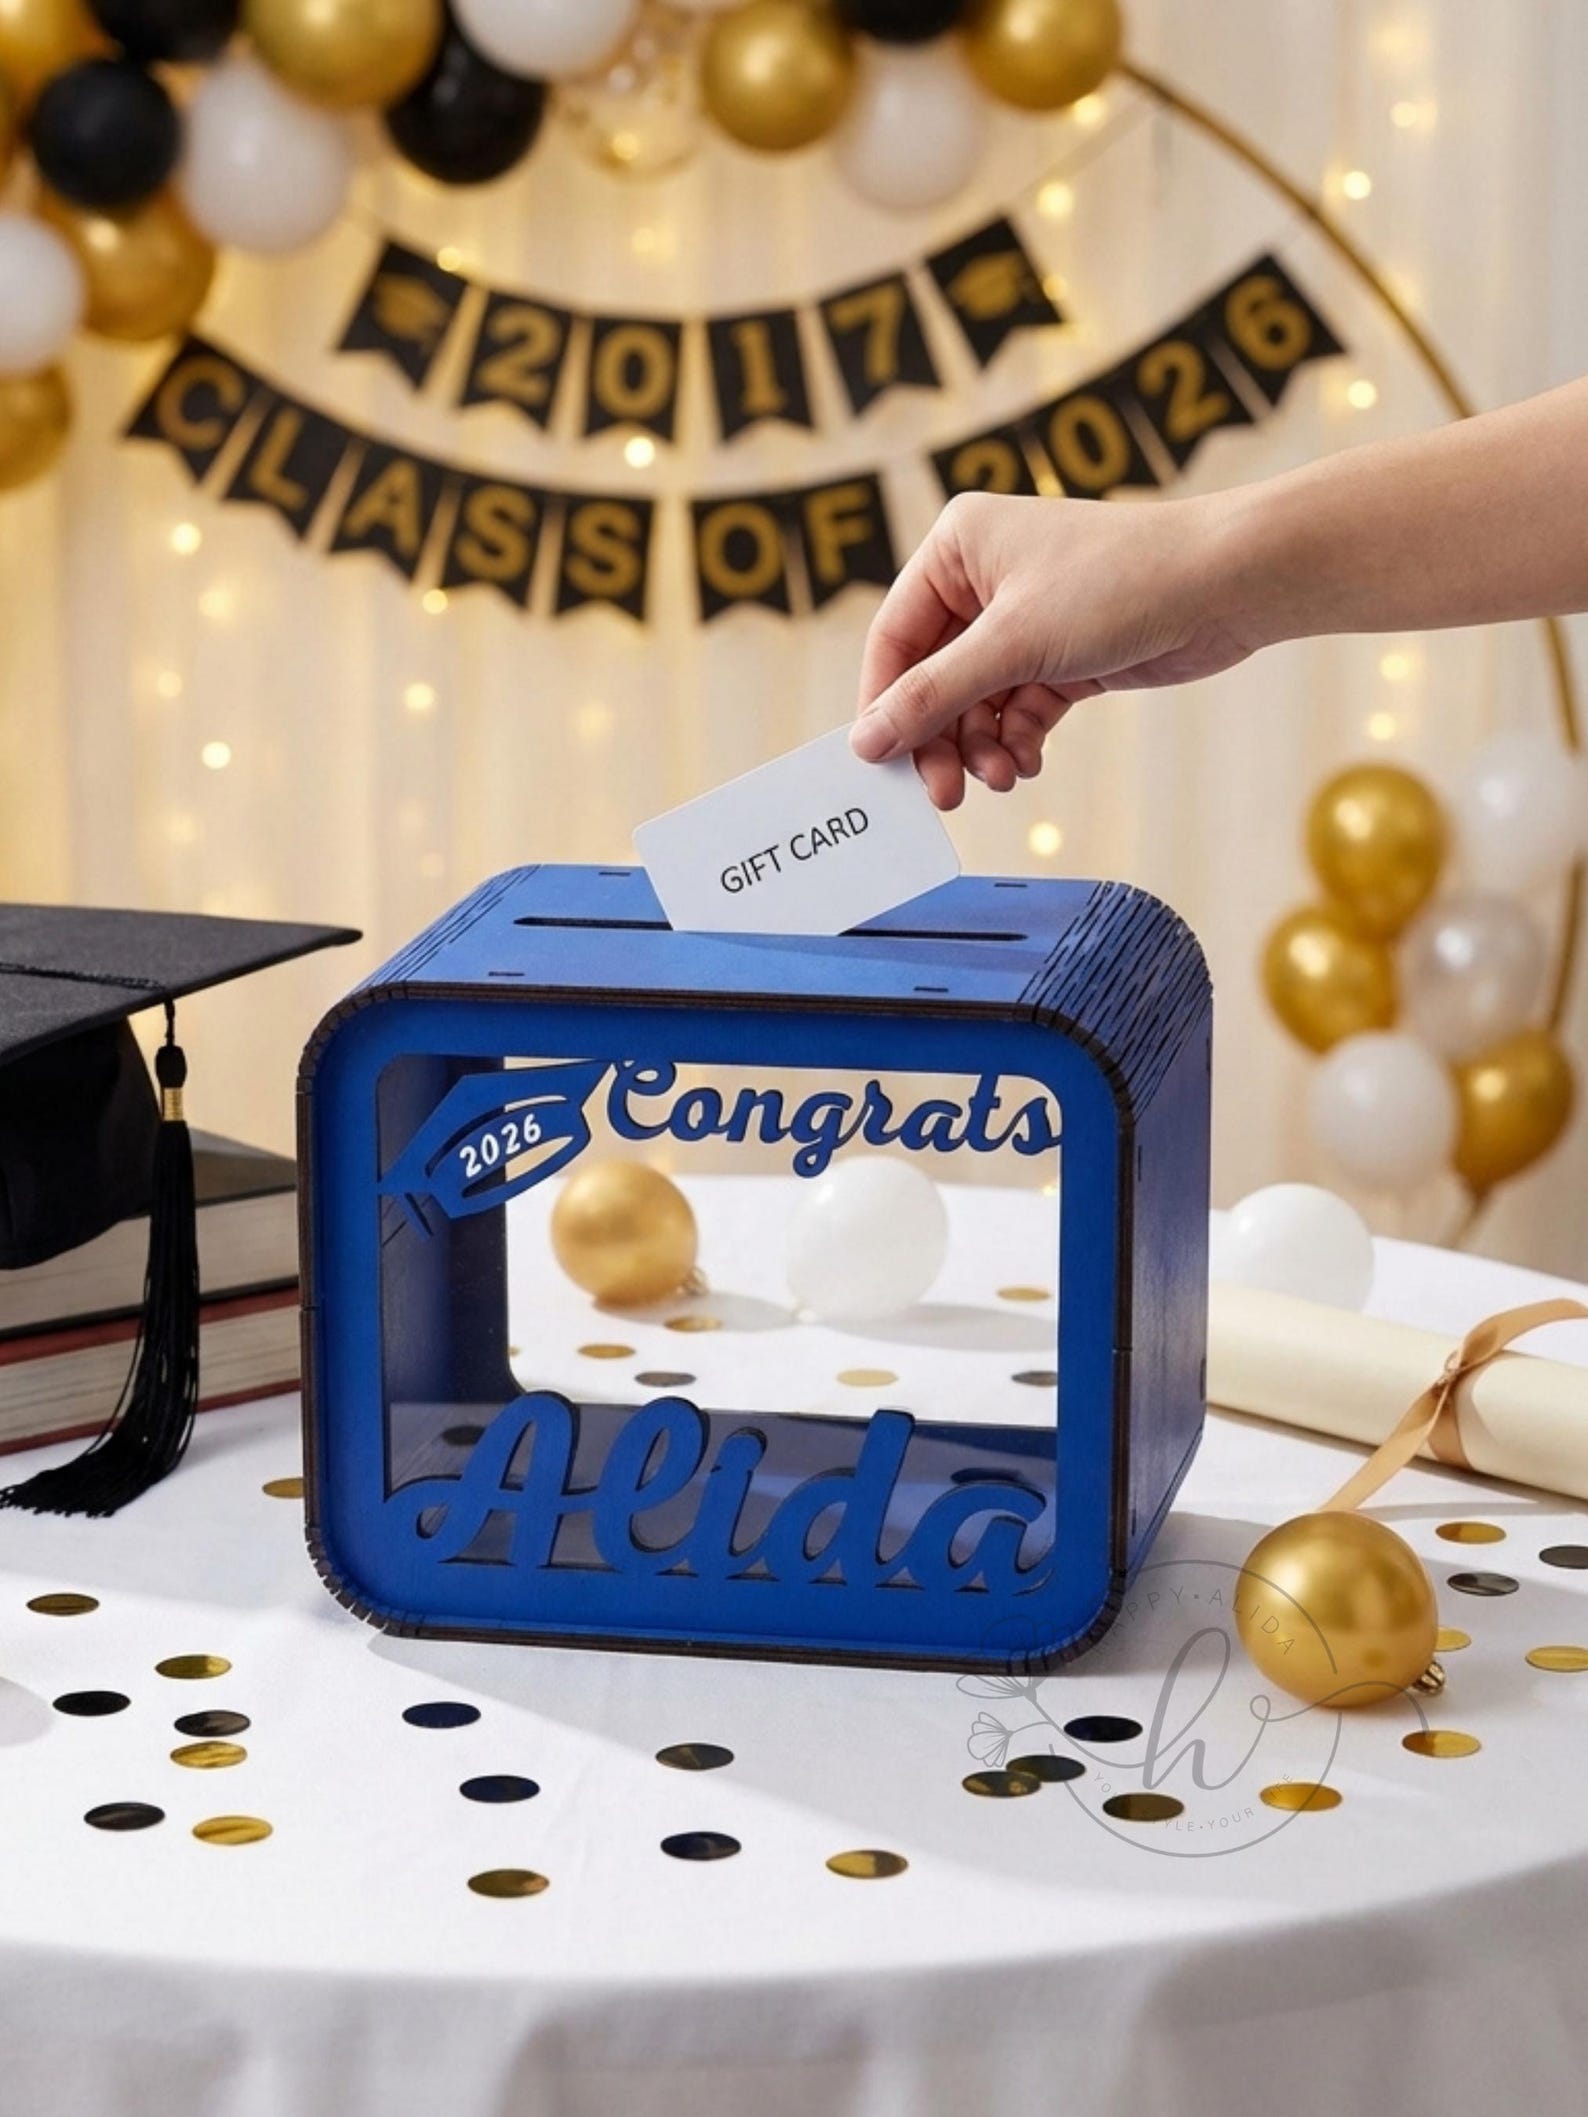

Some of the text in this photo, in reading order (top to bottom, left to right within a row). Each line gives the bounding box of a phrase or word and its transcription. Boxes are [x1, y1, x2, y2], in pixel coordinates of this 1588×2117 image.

[475, 283, 900, 419] 2017
[154, 354, 643, 600] CLASS
[702, 485, 872, 598] OF
[720, 807, 869, 894] GIFT CARD
[459, 1113, 541, 1178] 2026
[607, 1058, 1062, 1178] Congrats
[385, 1390, 1056, 1592] Alida
